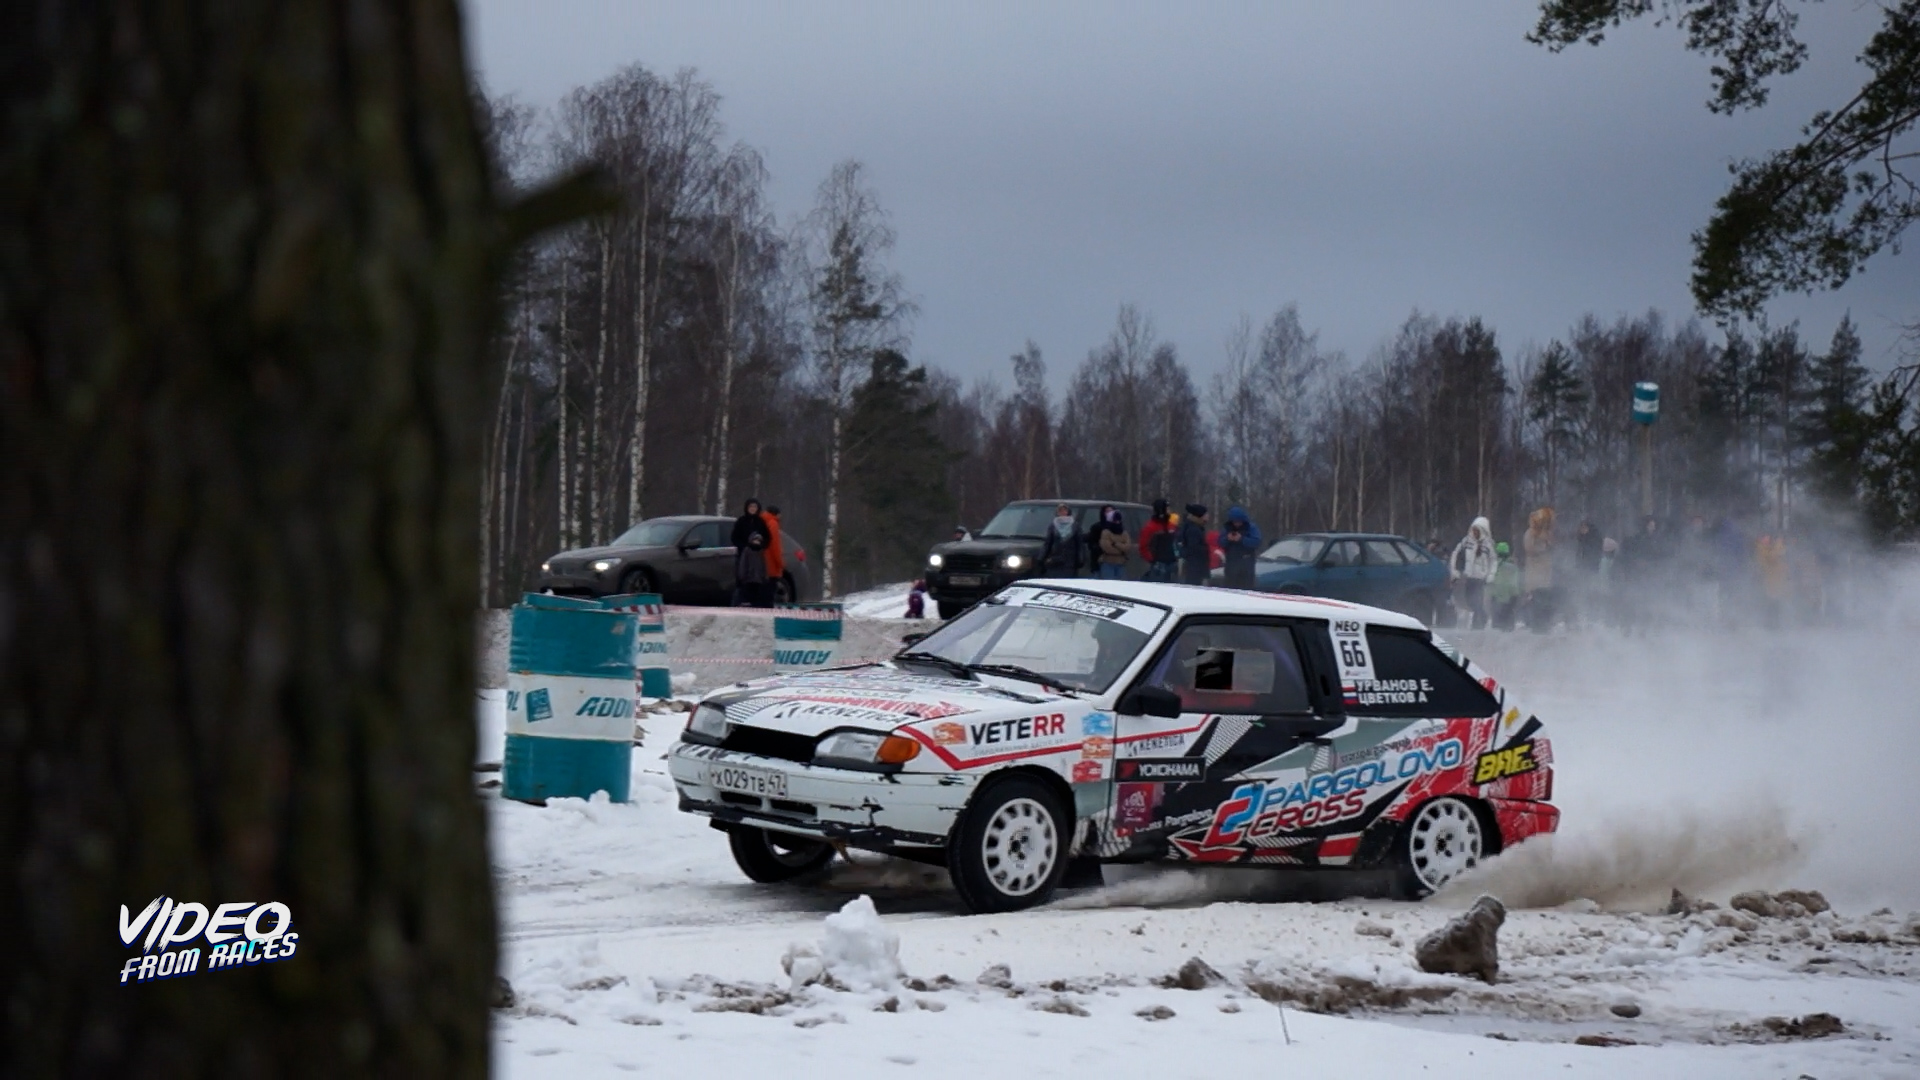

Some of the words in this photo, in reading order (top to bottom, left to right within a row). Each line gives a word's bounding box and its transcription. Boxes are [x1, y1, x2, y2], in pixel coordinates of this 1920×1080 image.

[1334, 621, 1360, 632] NEO
[1341, 640, 1366, 667] 66
[1356, 679, 1418, 692] УРВАНОВ
[1358, 691, 1416, 706] ЦВЕТКОВ
[971, 713, 1065, 745] VETERR
[1139, 763, 1200, 777] YOKOHAMA
[1261, 740, 1462, 809] PARGOLOVO
[1250, 789, 1367, 837] CROSS
